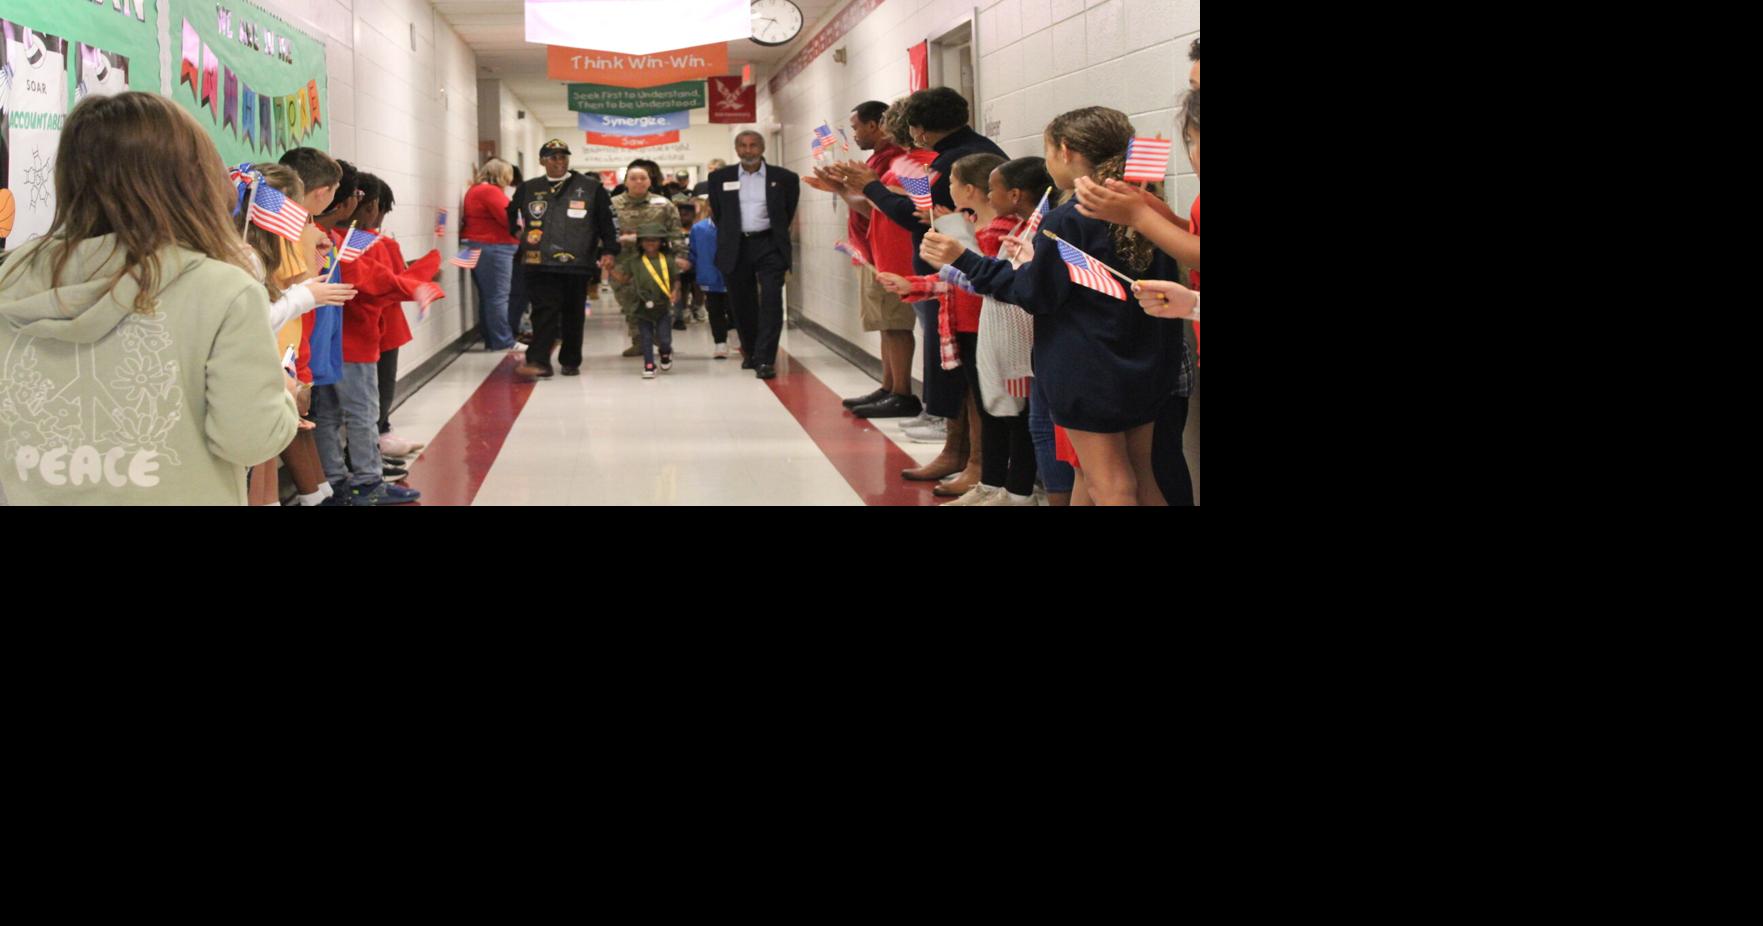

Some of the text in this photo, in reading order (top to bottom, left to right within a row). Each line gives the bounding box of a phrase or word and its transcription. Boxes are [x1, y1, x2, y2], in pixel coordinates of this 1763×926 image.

[571, 54, 713, 70] Think Win-Win.
[26, 79, 47, 95] SOAR
[573, 92, 599, 100] Seek
[601, 91, 623, 100] First
[624, 91, 636, 99] to
[577, 101, 605, 109] Then
[605, 101, 617, 109] to
[619, 100, 634, 109] be
[602, 116, 672, 127] Synergize.
[15, 445, 161, 487] PEACE
